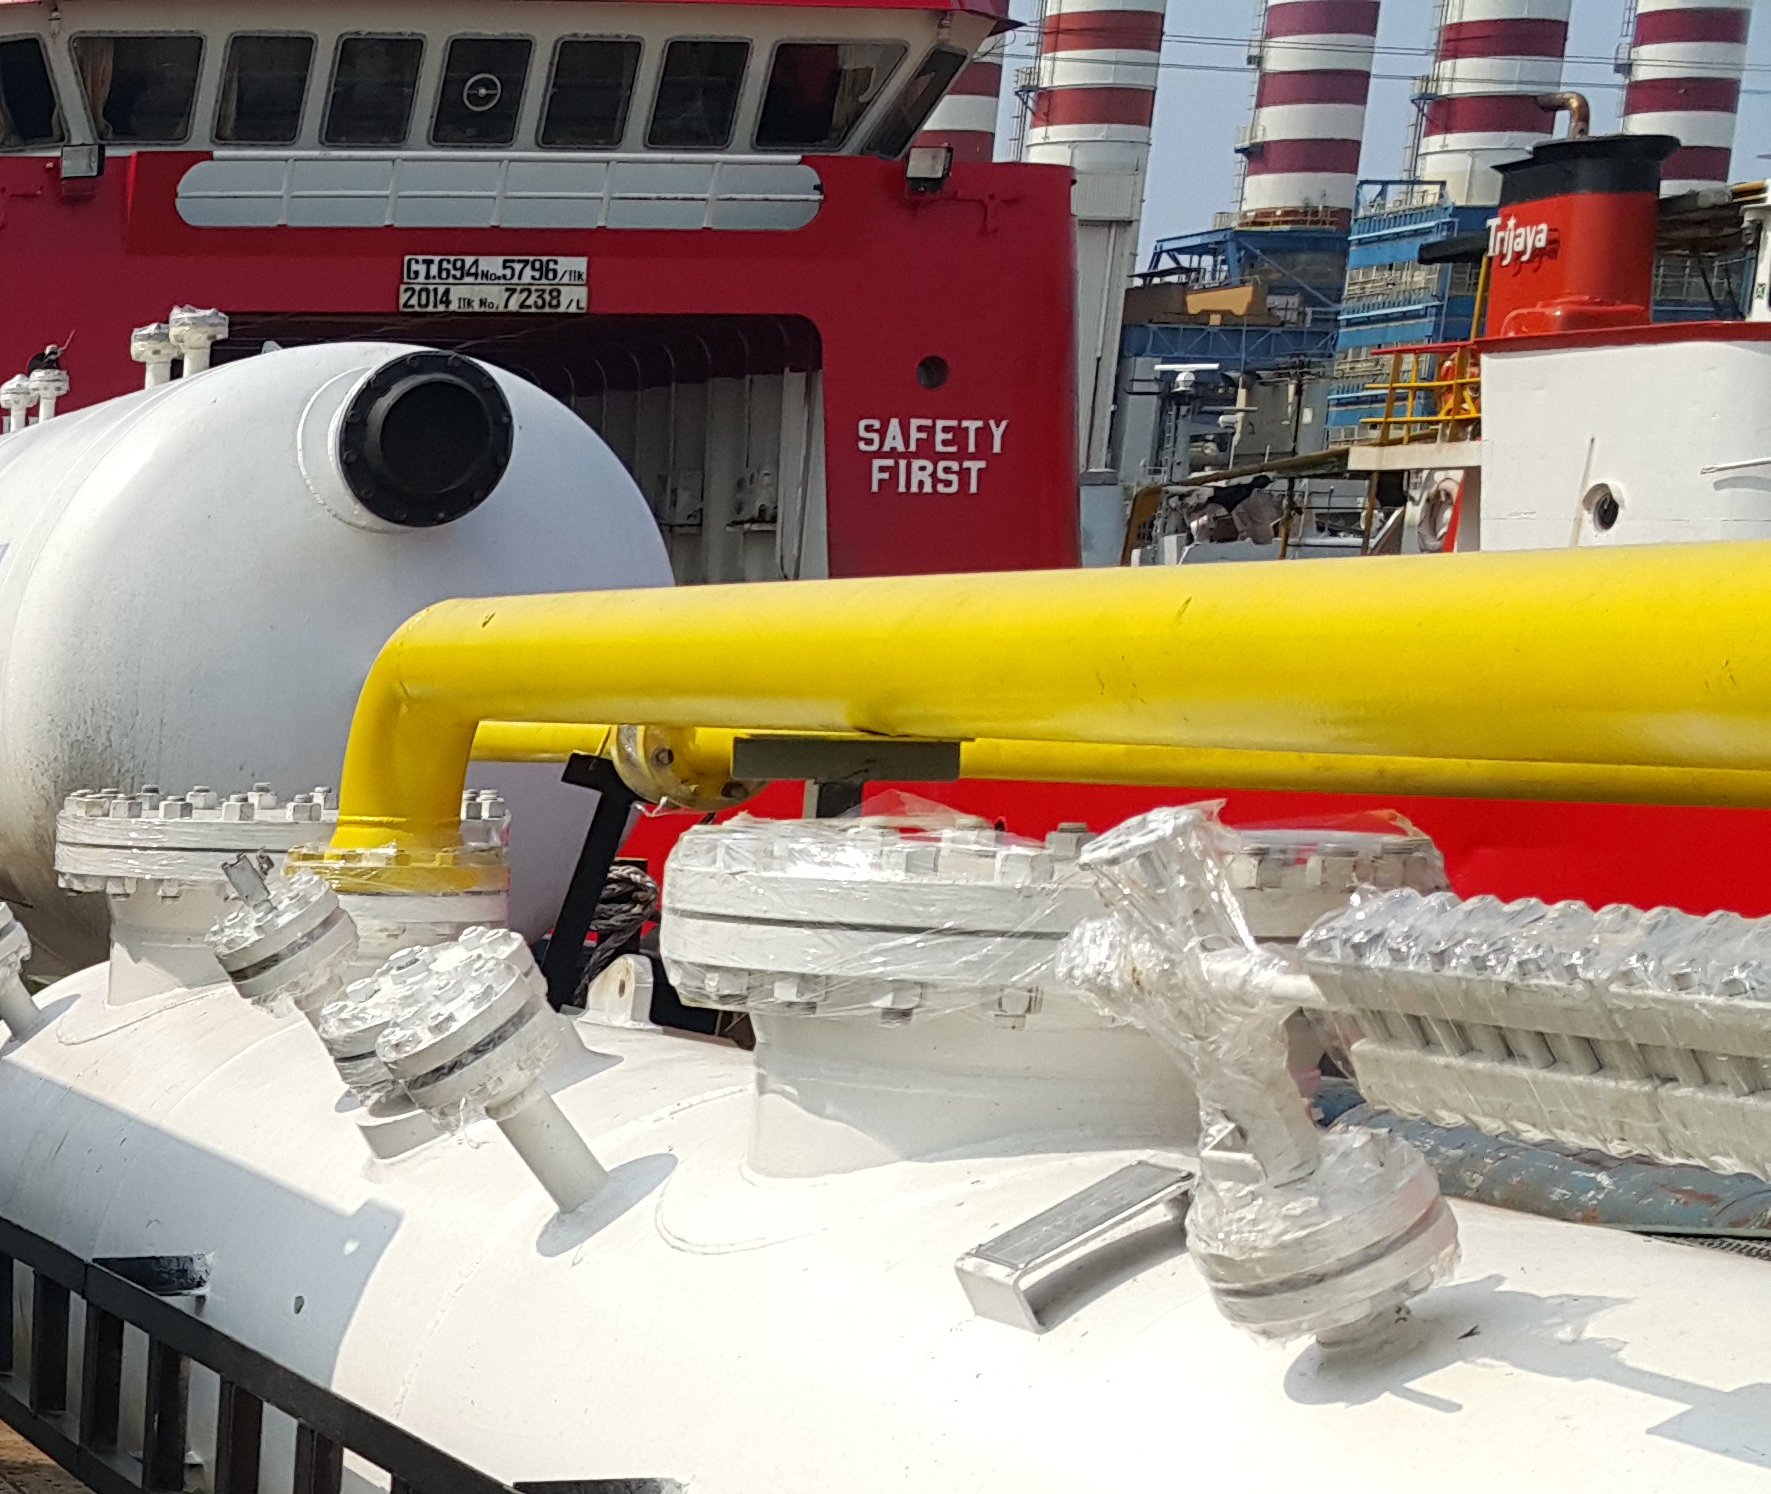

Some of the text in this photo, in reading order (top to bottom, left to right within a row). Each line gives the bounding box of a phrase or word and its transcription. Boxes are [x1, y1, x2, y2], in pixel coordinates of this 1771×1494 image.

[1486, 214, 1548, 266] Trijaya
[402, 286, 452, 310] 2014
[504, 287, 562, 310] 7238
[858, 418, 1009, 453] SAFETY
[871, 459, 987, 494] FIRST
